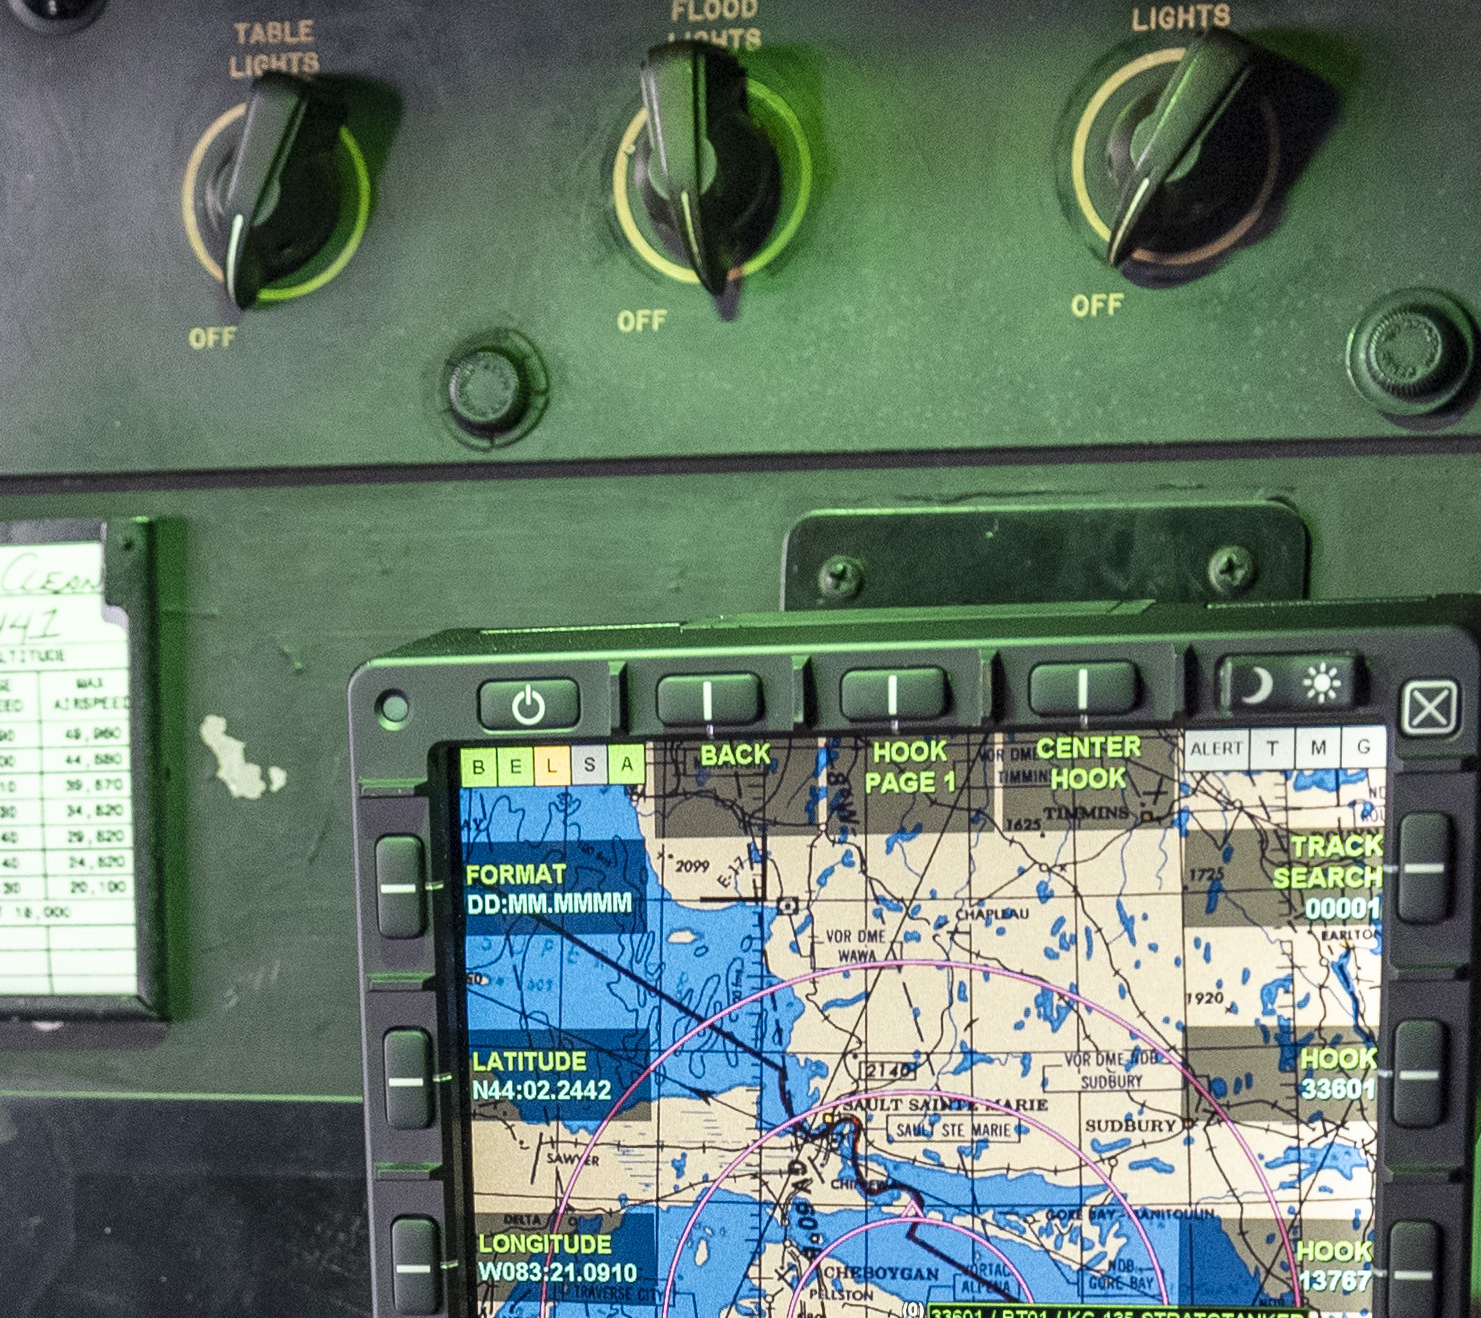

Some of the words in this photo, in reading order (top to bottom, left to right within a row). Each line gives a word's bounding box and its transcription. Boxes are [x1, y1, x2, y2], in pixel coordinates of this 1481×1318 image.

[671, 0, 758, 23] FLOOD
[1131, 5, 1230, 31] LIGHTS
[234, 19, 315, 45] TABLE
[230, 51, 319, 80] LIGHTS
[1072, 294, 1124, 319] OFF
[617, 309, 667, 333] OFF
[188, 327, 236, 350] OFF
[701, 743, 772, 766] BACK
[873, 740, 948, 763] HOOK
[1036, 735, 1141, 760] CENTER
[1190, 740, 1243, 756] ALERT
[1266, 740, 1279, 756] T
[1311, 740, 1326, 755] M
[1357, 739, 1371, 754] G
[472, 760, 485, 774] B
[511, 759, 523, 774] E
[548, 758, 558, 773] L
[584, 757, 596, 772] S
[620, 755, 634, 771] A
[865, 771, 936, 794] PAGE
[943, 769, 957, 792] 1
[1051, 766, 1126, 790] HOOK
[1043, 804, 1130, 821] TIMMINS
[1006, 818, 1041, 832] 1625
[1291, 834, 1383, 857] TRACK
[466, 862, 567, 885] FORMAT
[676, 858, 710, 873] 2099
[1189, 868, 1225, 883] 1725
[1272, 866, 1383, 889] SEARCH
[467, 890, 633, 914] DD:MM.MMMM
[1305, 897, 1380, 920] 00001
[955, 907, 1030, 922] CHAPLEAU
[826, 928, 853, 944] VOR
[857, 928, 886, 944] DME
[838, 948, 876, 964] WAWA
[1188, 991, 1224, 1005] 1920
[473, 1049, 587, 1072] LATITUDE
[1064, 1051, 1093, 1067] VOR
[1300, 1047, 1378, 1070] HOOK
[866, 1064, 911, 1078] 2140
[472, 1079, 612, 1101] N44:02.2442
[1080, 1074, 1143, 1090] SUDBURY
[1302, 1077, 1376, 1101] 33601
[842, 1098, 902, 1113] SAULT
[985, 1097, 1049, 1113] MARIE
[896, 1122, 933, 1138] SAULT
[942, 1122, 965, 1137] STE
[971, 1121, 1011, 1137] MARIE
[1085, 1118, 1175, 1133] SUDBURY
[546, 1152, 600, 1167] SAWYER
[479, 1234, 612, 1254] LONGITUDE
[1296, 1240, 1374, 1262] HOOK
[478, 1262, 638, 1283] W083:21.0910
[823, 1265, 939, 1282] CHEBOYGAN
[1298, 1269, 1373, 1292] 13767
[809, 1288, 874, 1302] PELLSTON
